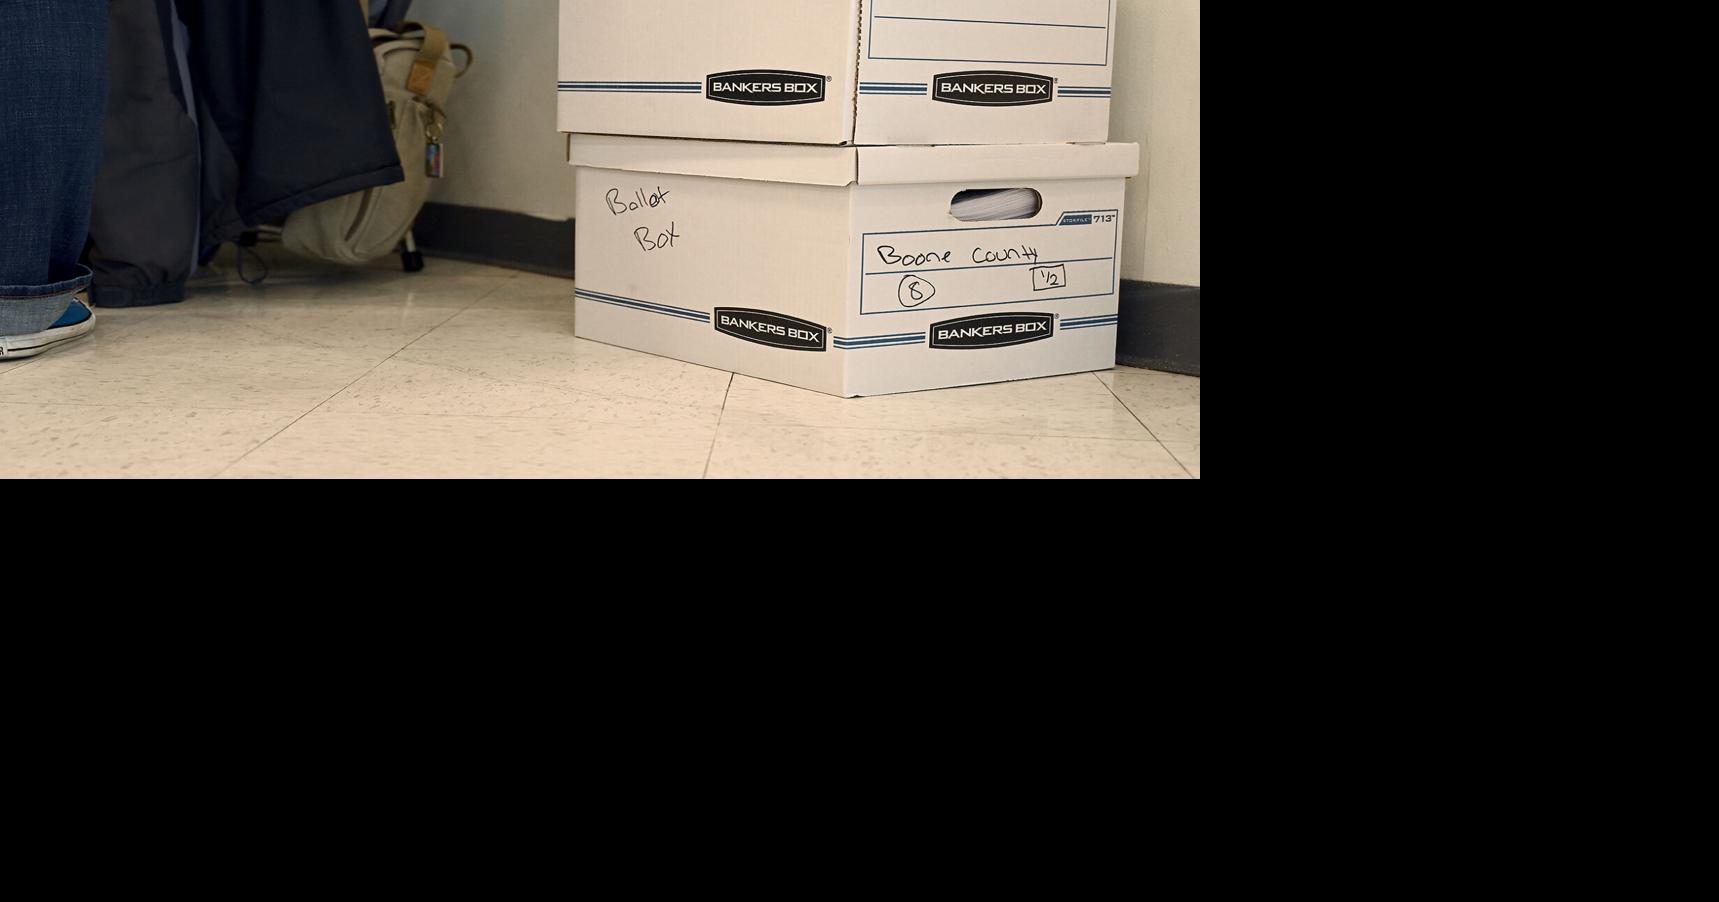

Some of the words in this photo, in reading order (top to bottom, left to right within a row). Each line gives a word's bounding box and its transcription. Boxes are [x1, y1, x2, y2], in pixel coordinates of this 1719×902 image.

[713, 82, 782, 93] BANKERS
[784, 83, 818, 94] BOX
[941, 82, 1014, 95] BANKERS
[1016, 84, 1047, 95] BOX
[605, 186, 670, 216] Ballot
[633, 221, 680, 252] Box
[877, 245, 951, 266] Boone
[971, 244, 1039, 265] County
[908, 281, 924, 301] 8
[720, 315, 786, 336] BANKERS
[788, 328, 820, 343] BOX
[938, 324, 1013, 340] BANKERS
[1015, 321, 1047, 333] BOX
